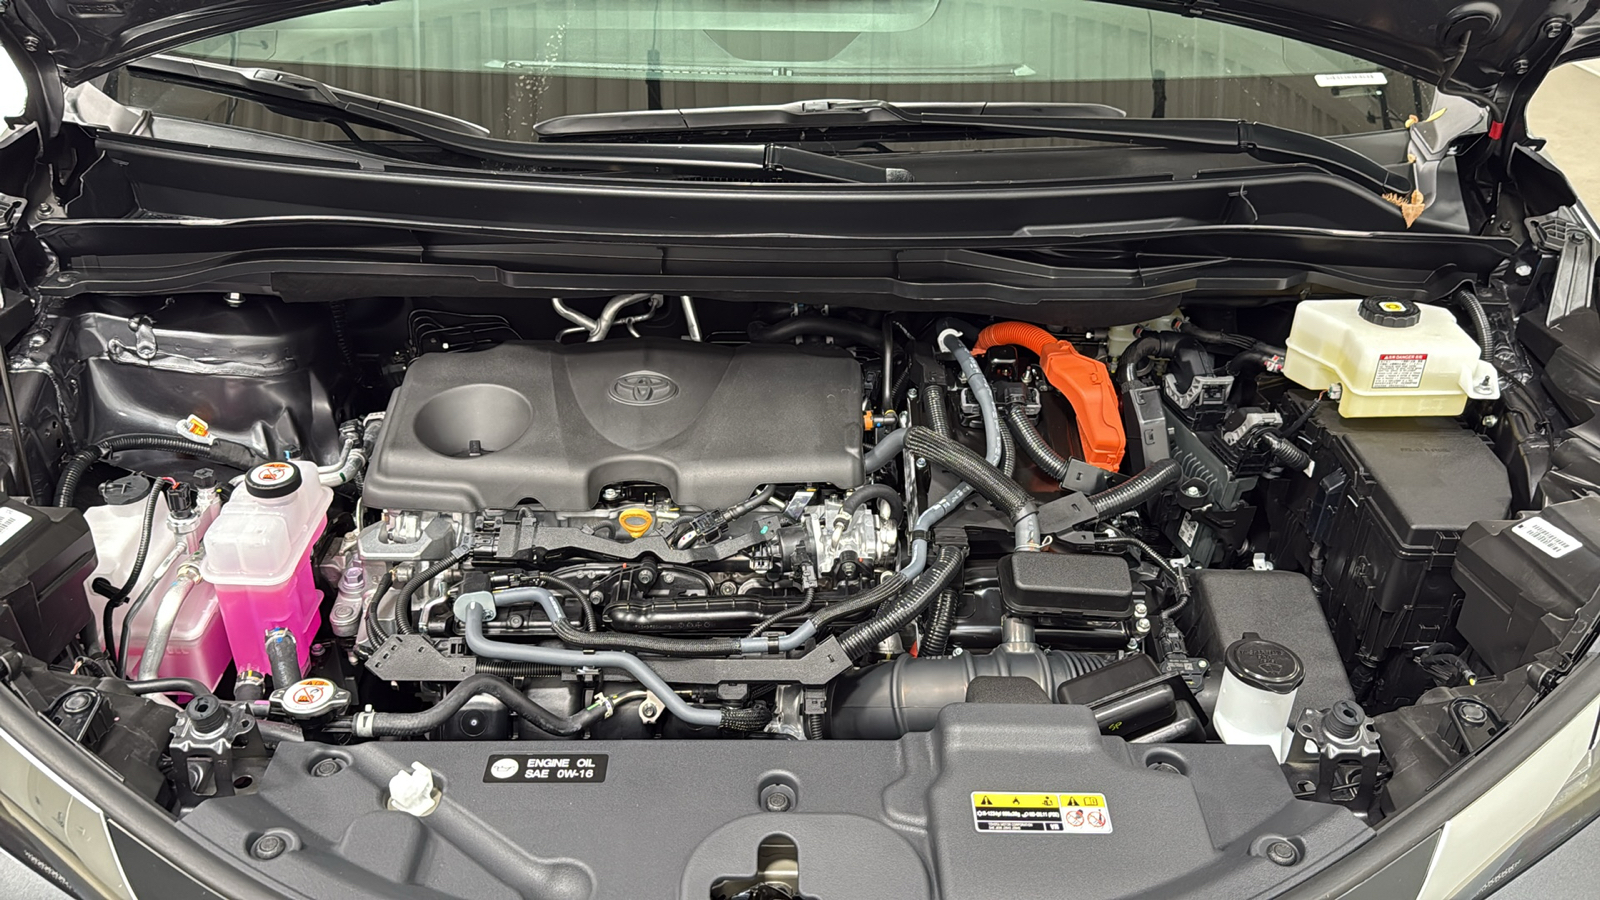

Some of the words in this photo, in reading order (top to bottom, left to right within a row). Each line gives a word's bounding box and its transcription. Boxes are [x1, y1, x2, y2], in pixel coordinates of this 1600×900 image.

[527, 758, 570, 767] ENGINE
[577, 758, 595, 767] OIL
[525, 769, 549, 778] SAE
[557, 769, 593, 778] 0W-16
